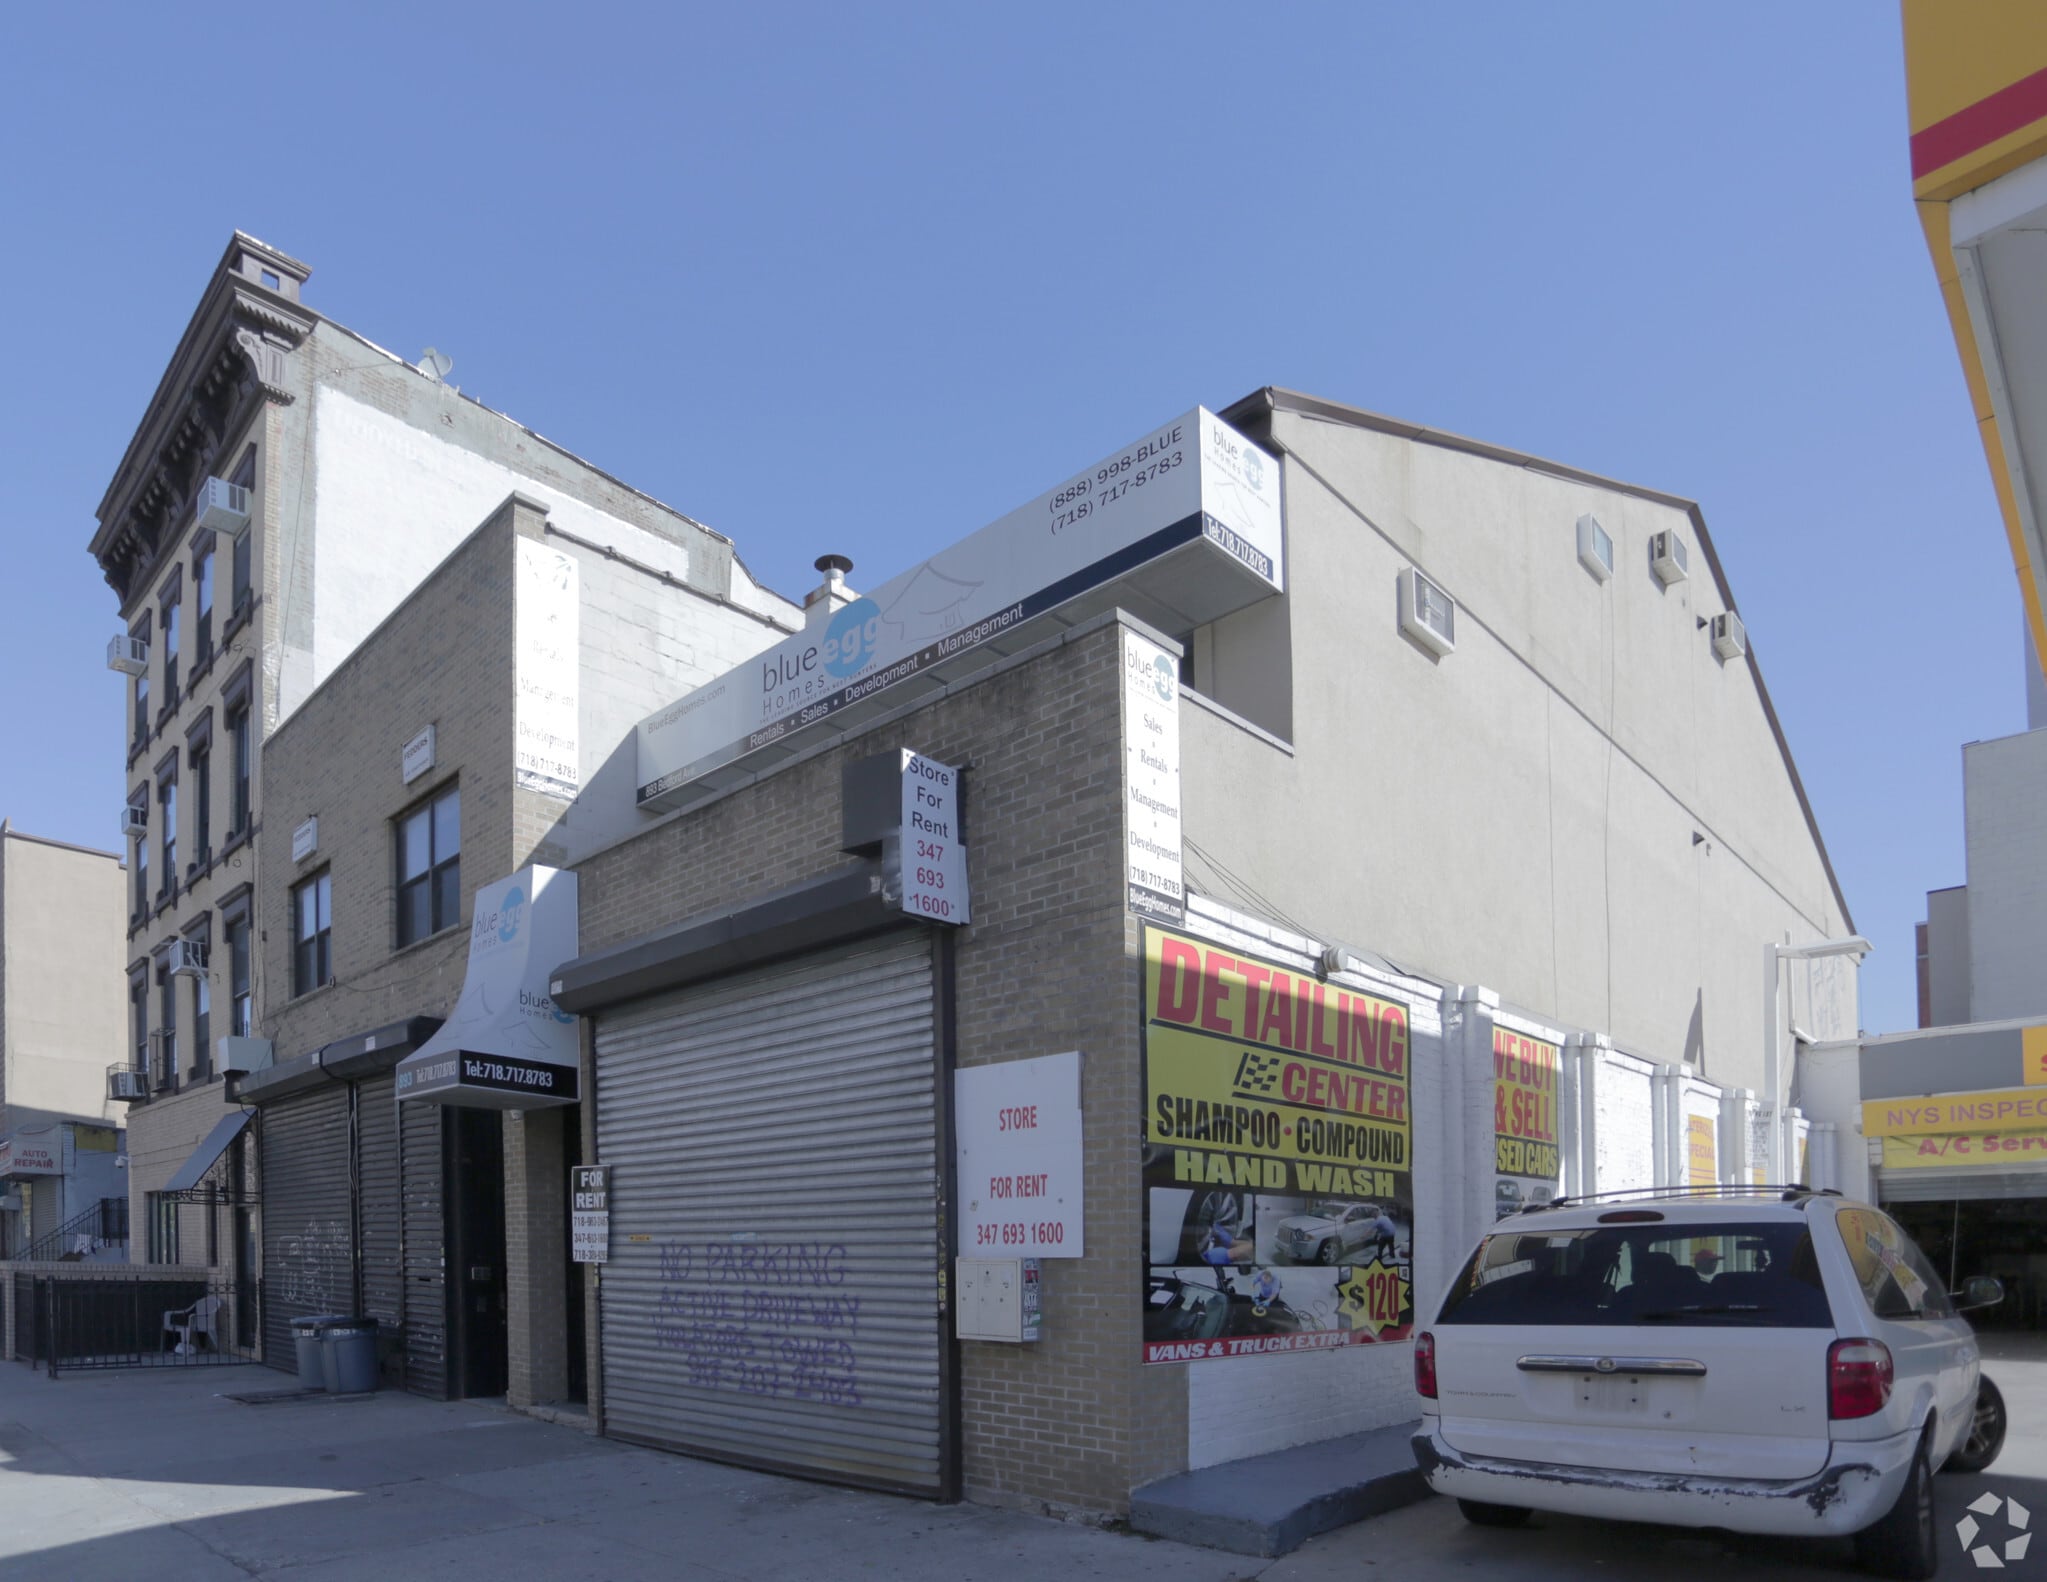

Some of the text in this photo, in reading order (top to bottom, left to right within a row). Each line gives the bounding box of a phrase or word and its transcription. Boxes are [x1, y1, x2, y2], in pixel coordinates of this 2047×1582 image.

[1213, 424, 1239, 460] blue
[1049, 478, 1093, 513] (888)
[1097, 425, 1183, 485] 998-BLUE
[1214, 446, 1241, 475] Homes
[1050, 500, 1094, 535] (718)
[1099, 451, 1183, 507] 717-8783
[762, 617, 879, 693] blue egg
[750, 603, 1024, 749] Rentals Sales Development Management
[1127, 645, 1175, 695] blue egg
[1128, 671, 1155, 694] Homes
[763, 674, 825, 716] Homes
[1143, 713, 1163, 735] Sales
[909, 755, 949, 787] Store
[1140, 749, 1168, 774] Rentals
[645, 780, 658, 798] 893
[917, 785, 942, 809] For
[1130, 786, 1178, 820] Management
[912, 811, 949, 839] Rent
[916, 840, 944, 862] 347
[1130, 830, 1180, 863] Development
[916, 867, 944, 889] 693
[1129, 865, 1180, 896] (718) 717-8783
[913, 893, 949, 917] 1600
[474, 911, 498, 938] blue
[519, 989, 549, 1010] blue
[1156, 937, 1406, 1074] DETAILING
[464, 1060, 553, 1088] Tel:718.717.8783
[1519, 1040, 1556, 1091] BUY
[1281, 1062, 1406, 1121] CENTER
[999, 1105, 1037, 1131] STORE
[1511, 1087, 1553, 1142] SELL
[1887, 1106, 1940, 1127] NYS
[1156, 1094, 1404, 1165] SHAMPOO COMPOUND
[22, 1149, 48, 1158] AUTO
[1917, 1136, 1971, 1156] A/C
[14, 1159, 54, 1168] REPAIR
[1174, 1149, 1395, 1198] HAND WASH
[1525, 1144, 1557, 1178] CARS
[581, 1171, 604, 1187] FOR
[990, 1174, 1048, 1199] FOR RENT
[576, 1191, 606, 1209] RENT
[977, 1222, 1064, 1245] 347 693 1600
[659, 1240, 850, 1288] NO PARKING
[1149, 1331, 1350, 1362] VANS & TRUCK EXTRA
